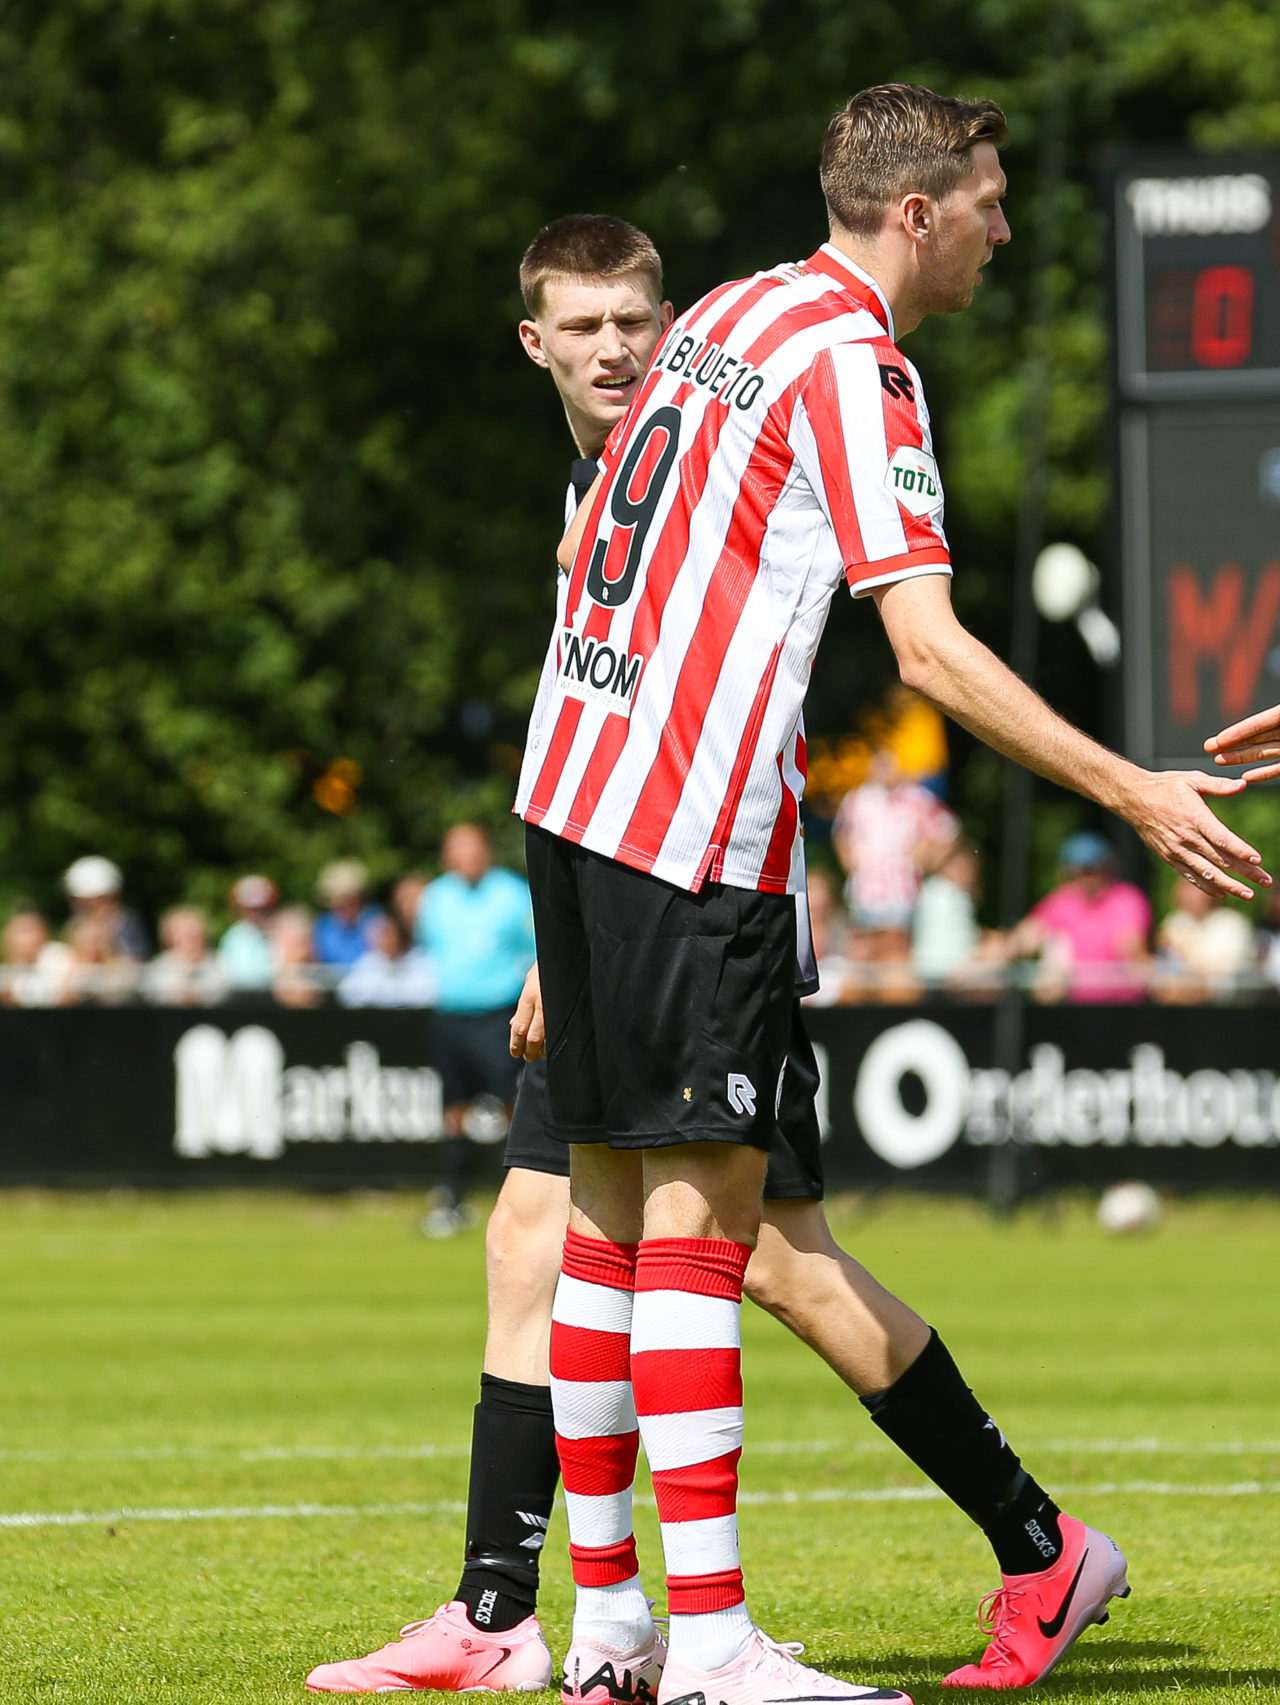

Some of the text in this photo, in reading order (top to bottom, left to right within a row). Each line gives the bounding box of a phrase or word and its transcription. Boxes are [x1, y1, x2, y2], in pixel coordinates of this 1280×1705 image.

[1193, 265, 1254, 368] 0
[587, 405, 682, 607] 9
[173, 1024, 443, 1159] Marku
[1024, 1519, 1057, 1557] SOCKS
